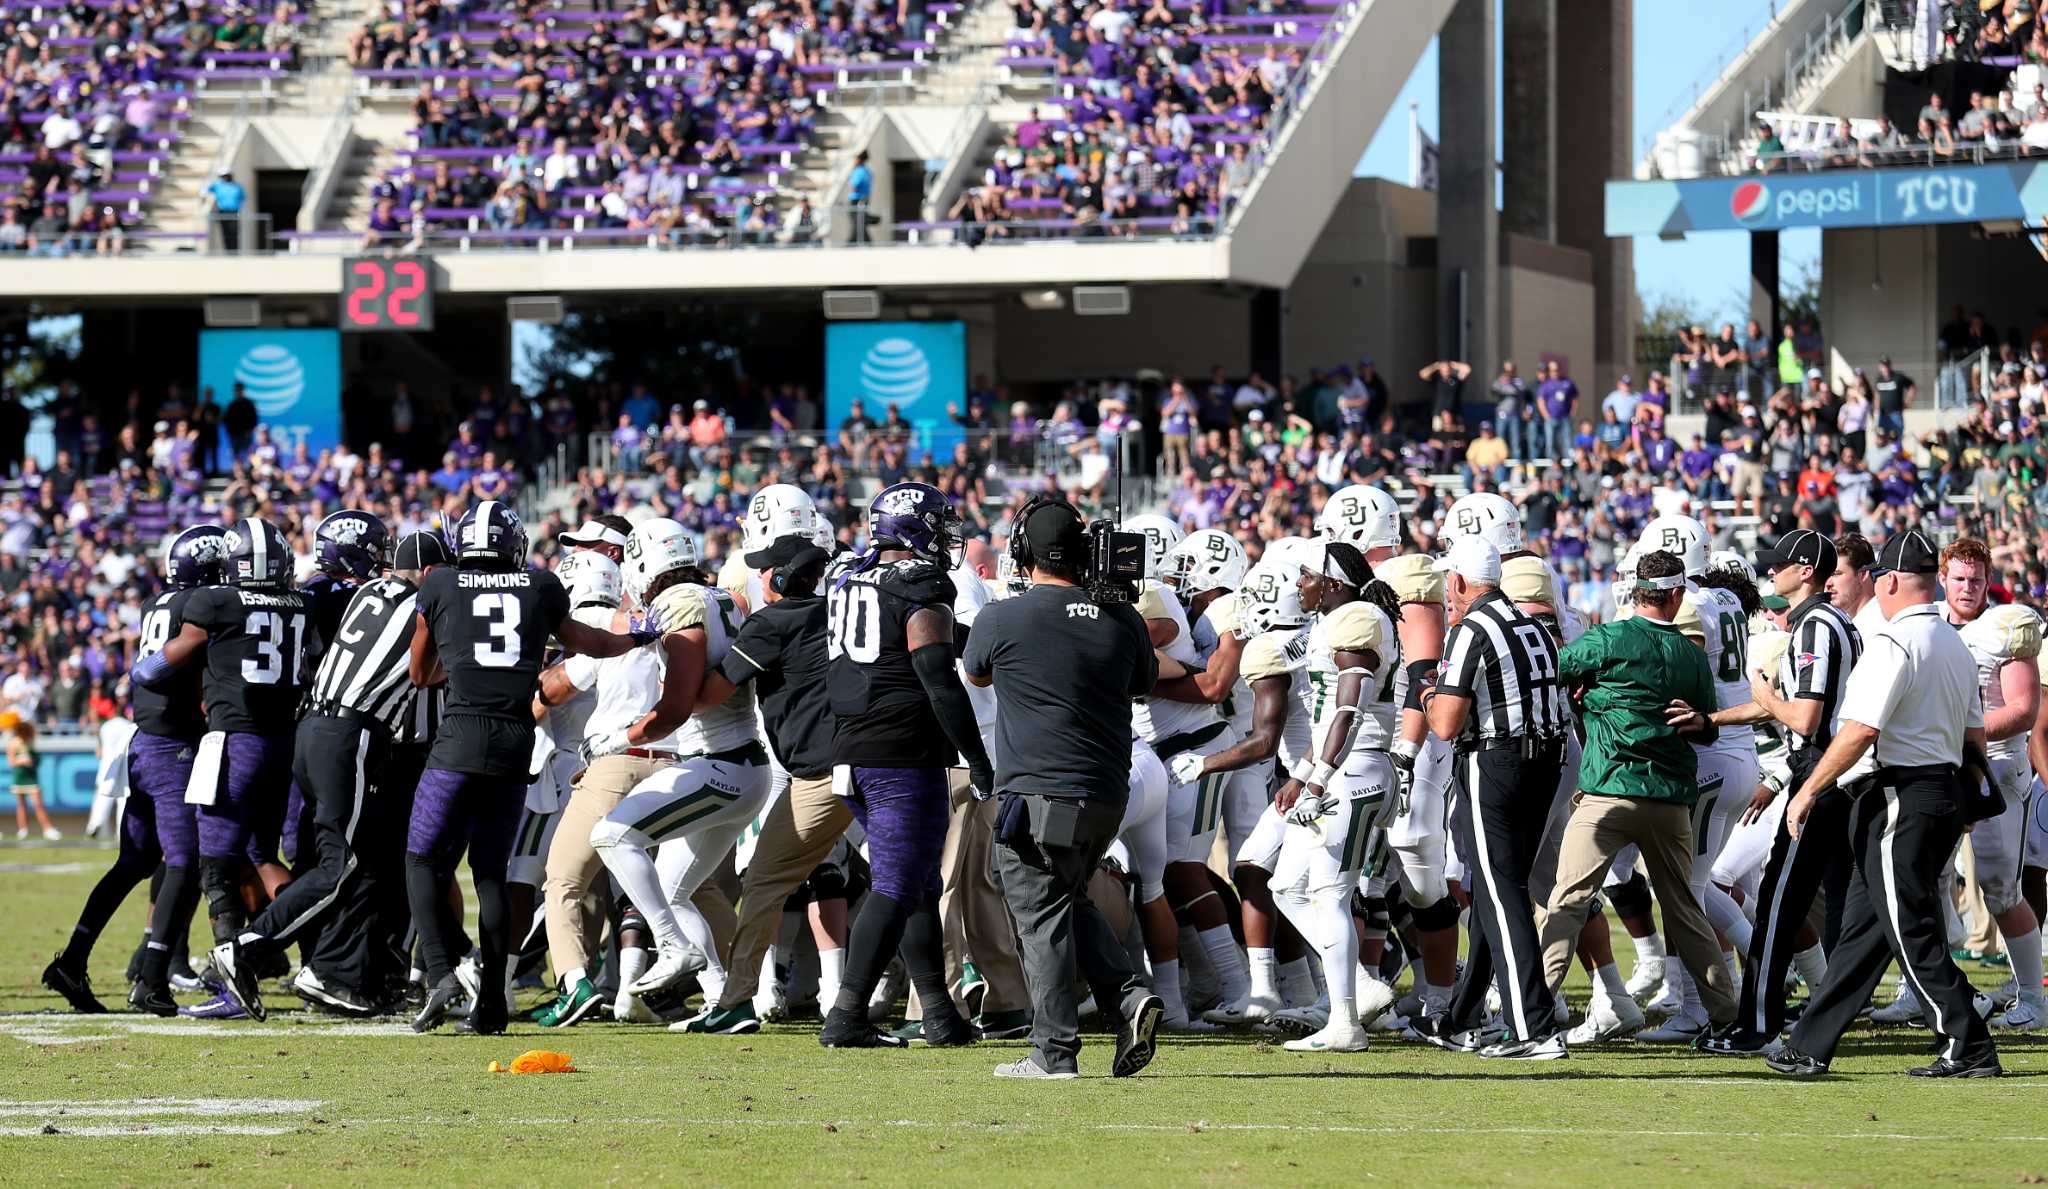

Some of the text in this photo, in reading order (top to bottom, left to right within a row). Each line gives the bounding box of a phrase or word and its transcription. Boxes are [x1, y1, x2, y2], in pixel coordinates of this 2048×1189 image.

[1776, 180, 1860, 220] pepsi
[1895, 175, 1977, 218] TCU
[347, 261, 425, 325] 22
[753, 495, 770, 522] BU
[884, 489, 924, 506] TCU
[1341, 497, 1367, 526] BU
[1457, 507, 1482, 534] BU
[330, 518, 368, 535] TCU
[626, 533, 642, 559] BU
[1144, 528, 1167, 554] BU
[1206, 534, 1231, 562] BU
[1662, 528, 1686, 555] BU
[458, 573, 530, 588] SIMMONS
[1257, 574, 1280, 603] BU
[340, 595, 384, 644] C
[1066, 603, 1099, 620] TCU
[473, 594, 521, 667] 3
[241, 612, 306, 685] 31
[1512, 624, 1555, 680] R
[710, 778, 741, 793] BAYLOR
[1352, 784, 1383, 797] BAYLOR
